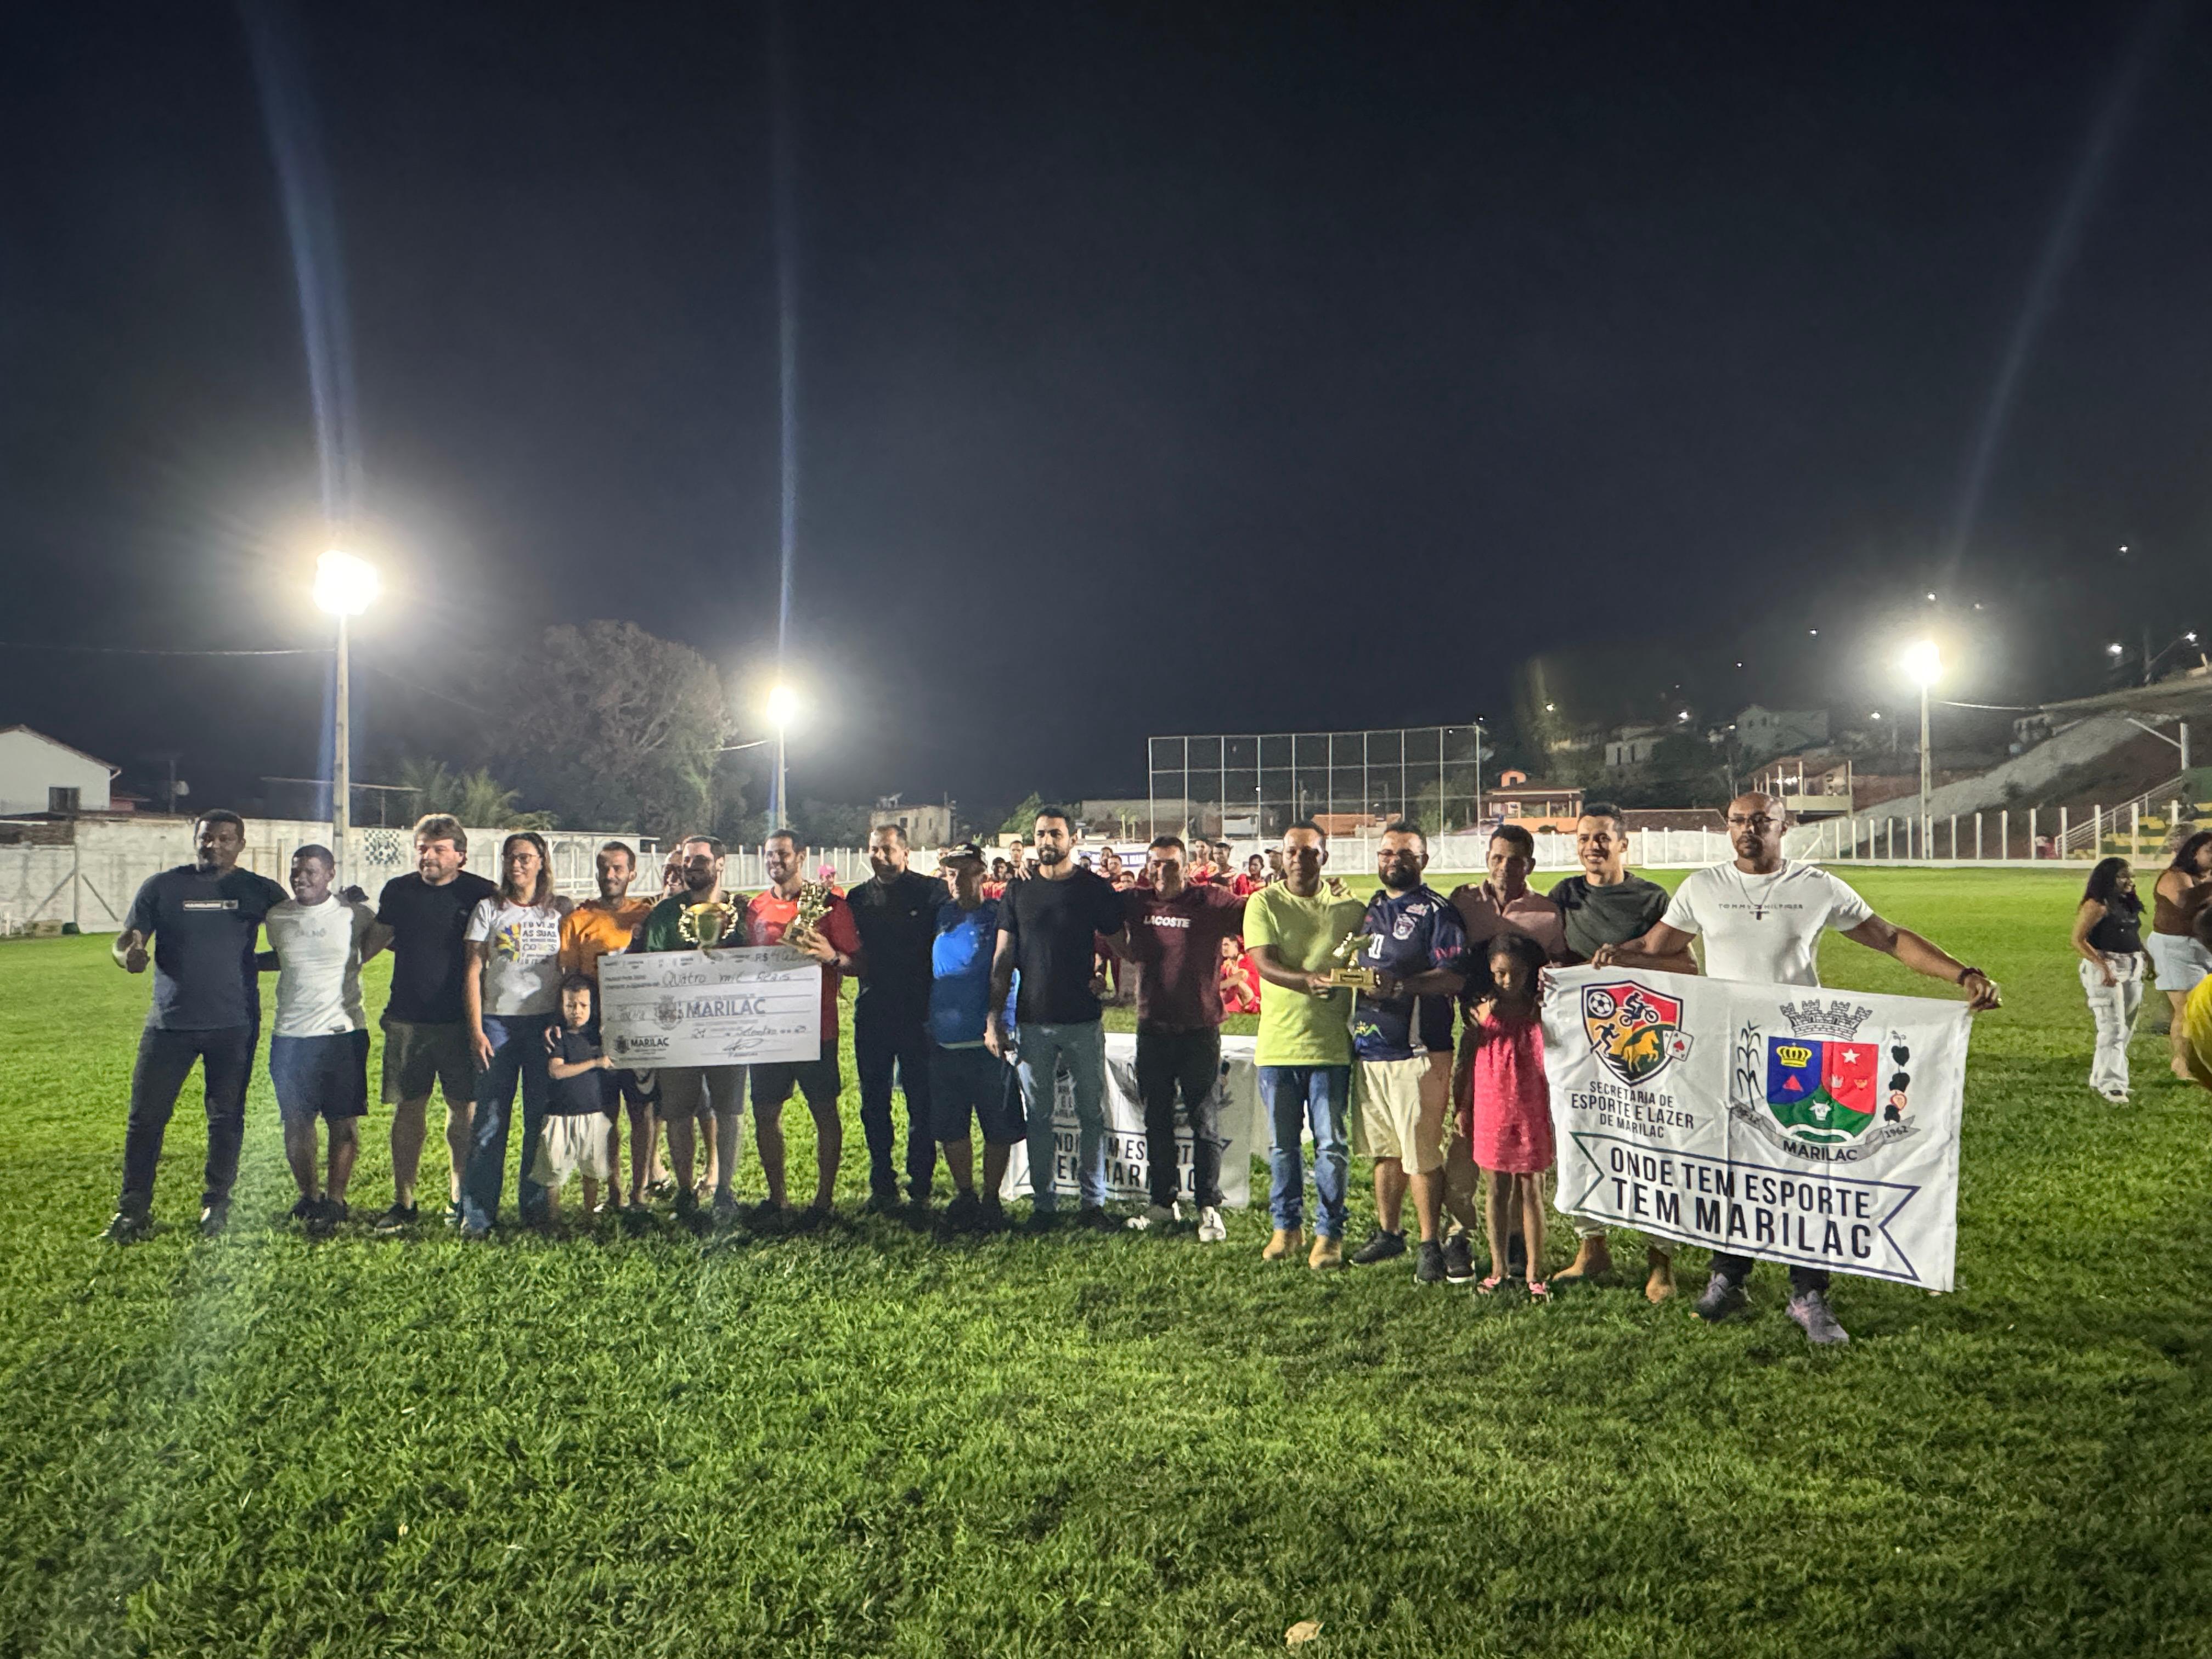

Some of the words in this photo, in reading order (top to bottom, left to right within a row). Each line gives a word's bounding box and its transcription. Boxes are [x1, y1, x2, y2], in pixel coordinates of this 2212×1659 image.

[1143, 915, 1190, 928] LACOSTE
[686, 998, 766, 1018] MARILAC
[631, 1037, 669, 1046] MARILAC
[1589, 1081, 1655, 1104] SECRETARIA
[1660, 1094, 1673, 1108] DE
[1571, 1093, 1631, 1118] ESPORTE
[1635, 1105, 1643, 1120] E
[1647, 1107, 1695, 1129] LAZER
[1600, 1113, 1613, 1126] DE
[1616, 1116, 1664, 1138] MARILAC
[1783, 1140, 1858, 1161] MARILAC
[1611, 1147, 1673, 1187] ONDE
[1681, 1162, 1735, 1197] TEM
[1745, 1174, 1871, 1219] ESPORTE
[1611, 1177, 1680, 1226] TEM
[1696, 1197, 1871, 1259] MARILAC
